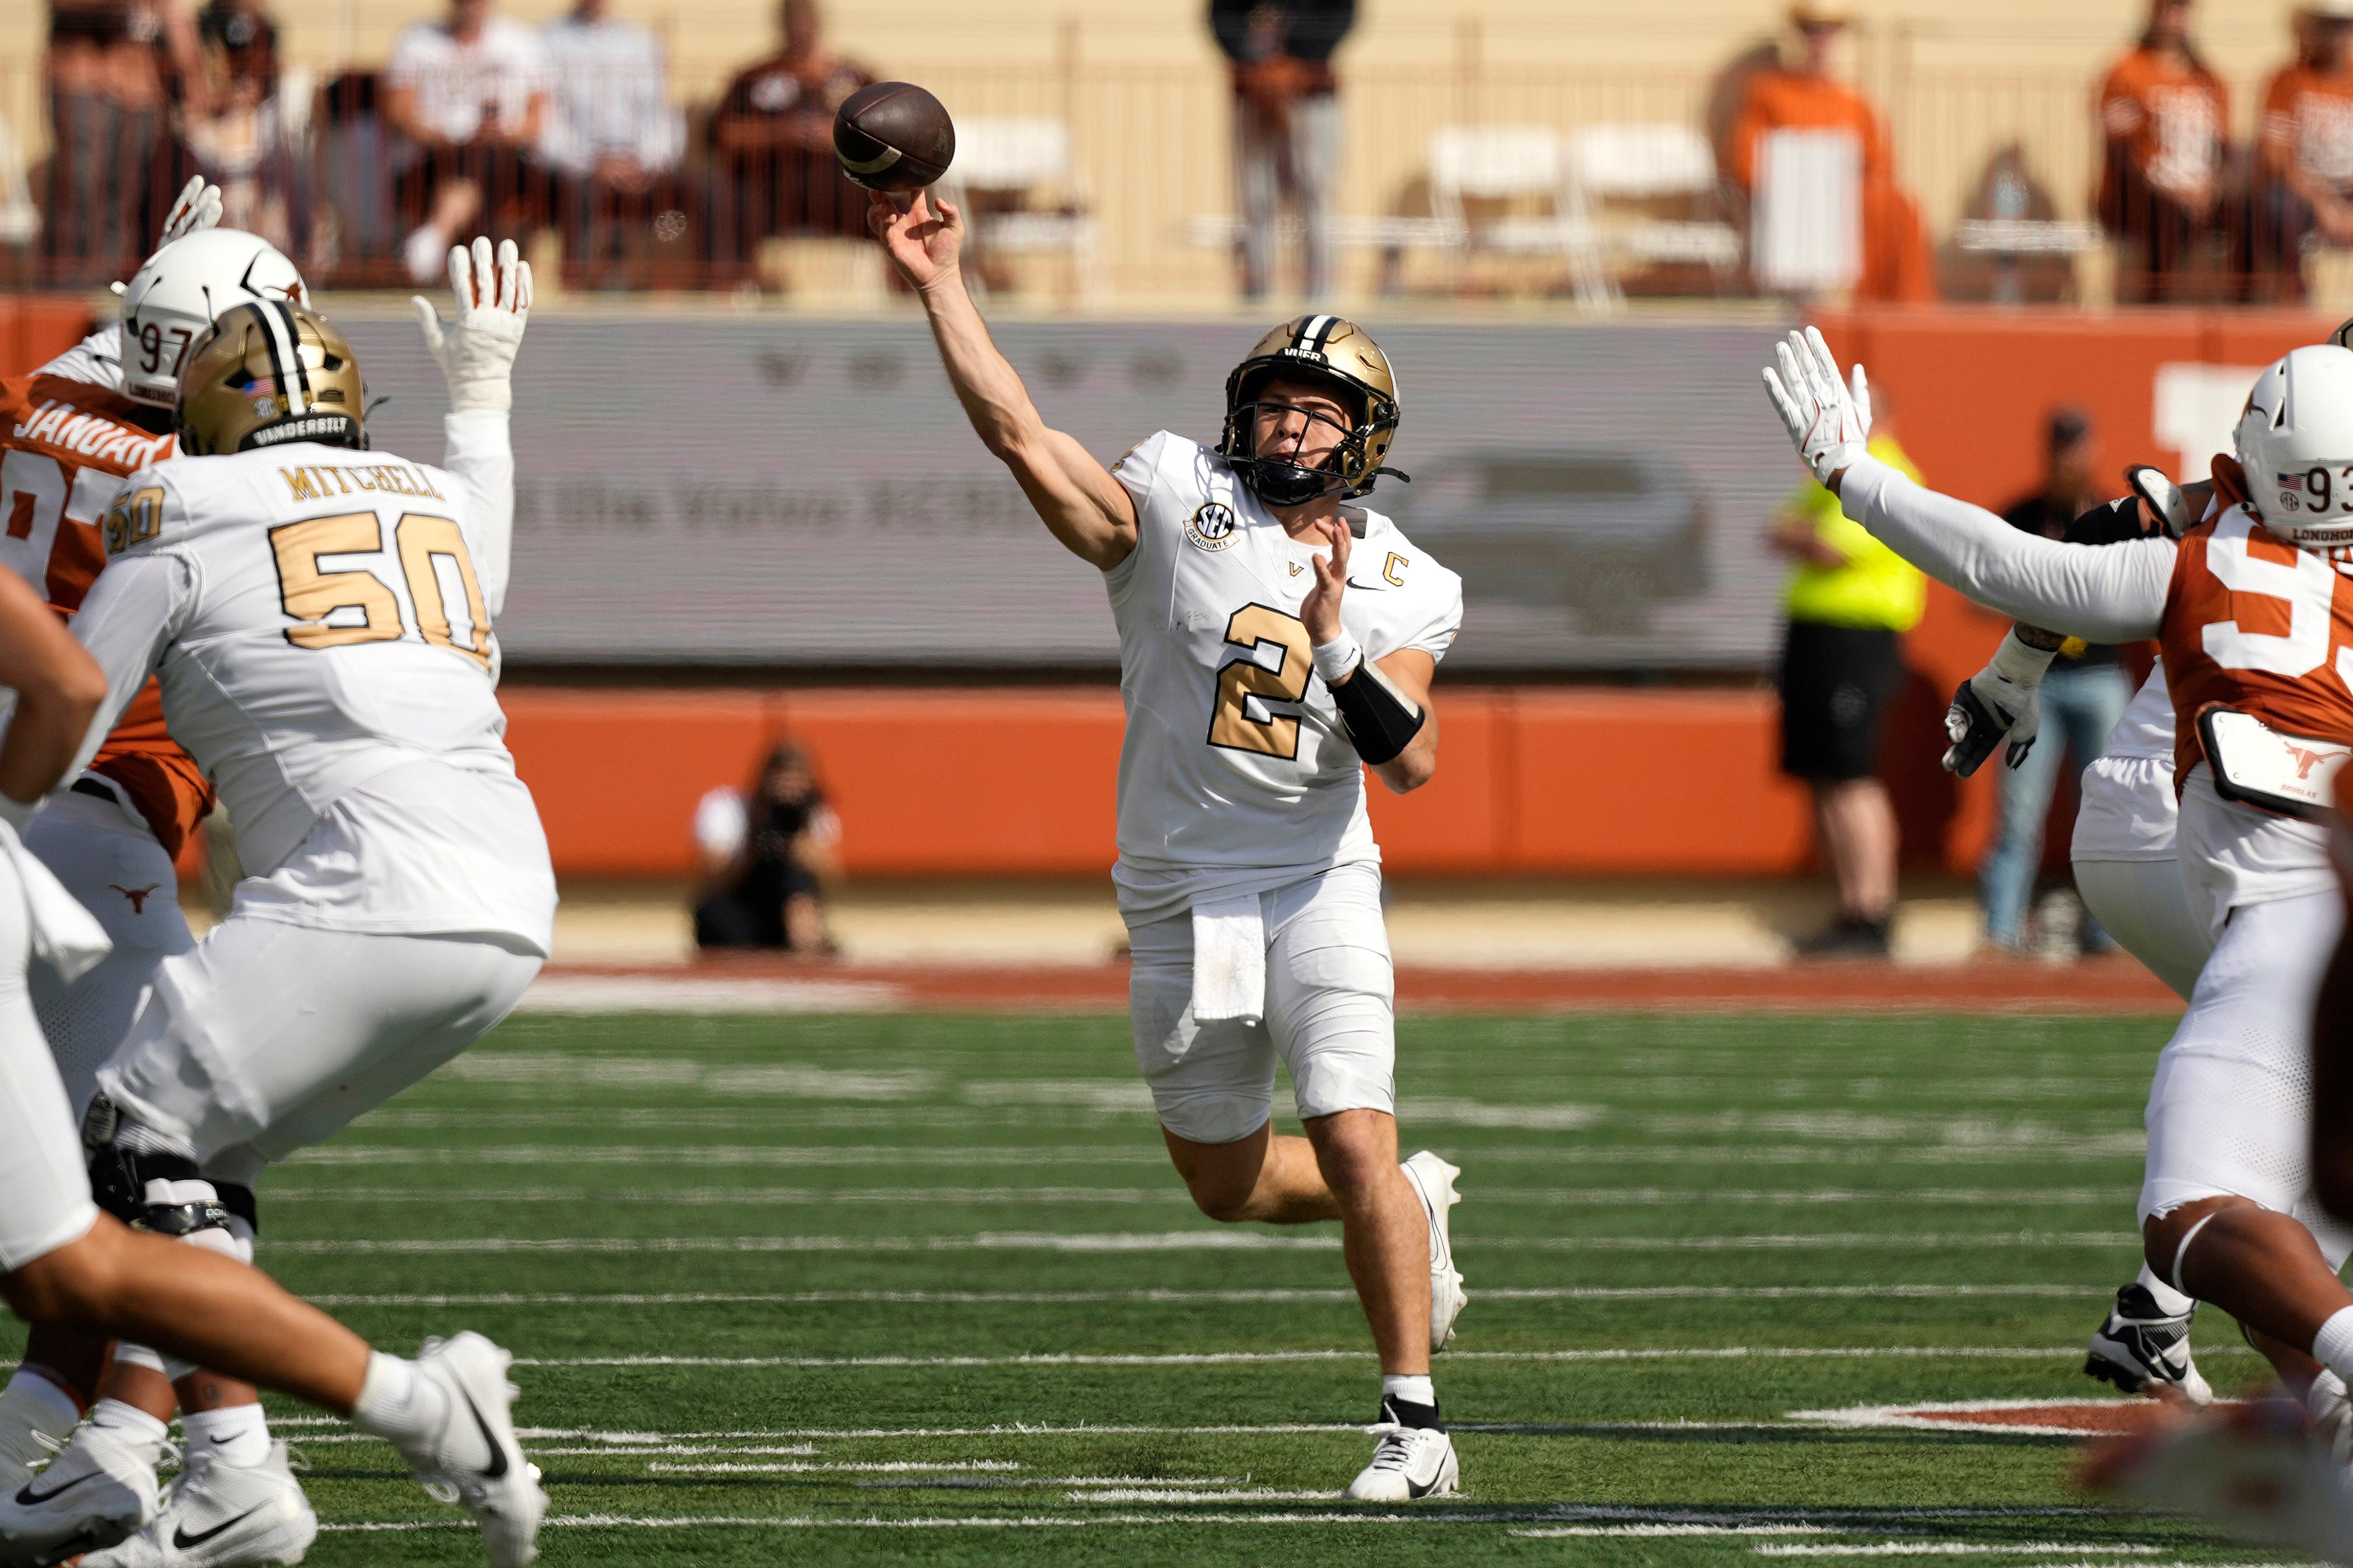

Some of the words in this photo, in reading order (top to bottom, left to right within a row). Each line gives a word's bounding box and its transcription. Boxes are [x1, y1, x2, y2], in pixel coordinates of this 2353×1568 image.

[140, 322, 193, 378] 97
[253, 416, 348, 446] VANDERBILT
[279, 466, 446, 502] MITCHELL
[106, 486, 166, 555] 50
[1196, 504, 1234, 539] SEC
[2293, 528, 2353, 542] LONGHO
[1188, 528, 1230, 550] GRADUATE
[1288, 561, 1305, 577] V
[1383, 551, 1409, 587] C
[268, 511, 493, 675] 50
[1207, 602, 1314, 761] 2
